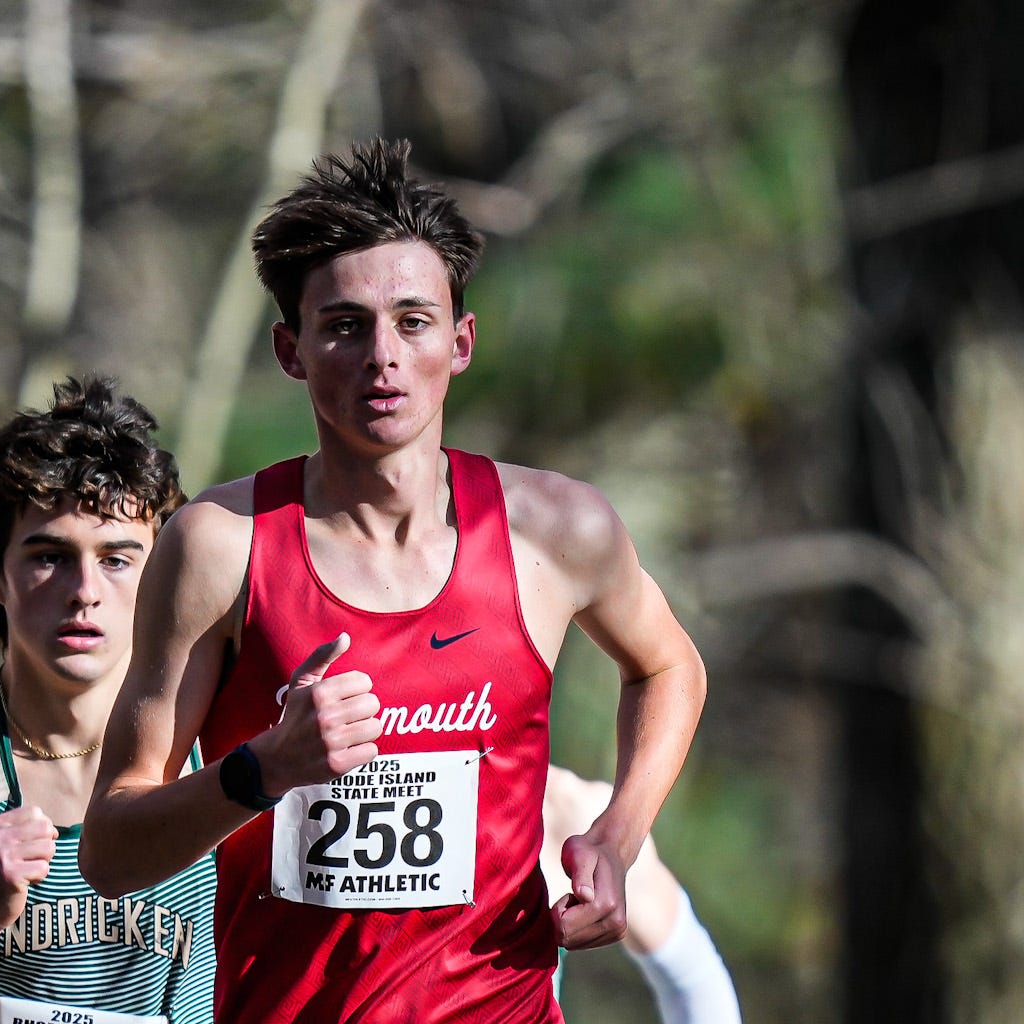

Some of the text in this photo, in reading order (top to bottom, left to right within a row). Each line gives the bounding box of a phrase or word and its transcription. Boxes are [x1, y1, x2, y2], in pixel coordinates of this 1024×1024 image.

[359, 760, 400, 772] 2025
[327, 772, 436, 786] HODE ISLAND
[331, 785, 424, 799] STATE MEET
[306, 799, 443, 869] 258
[339, 873, 440, 893] ATHLETIC
